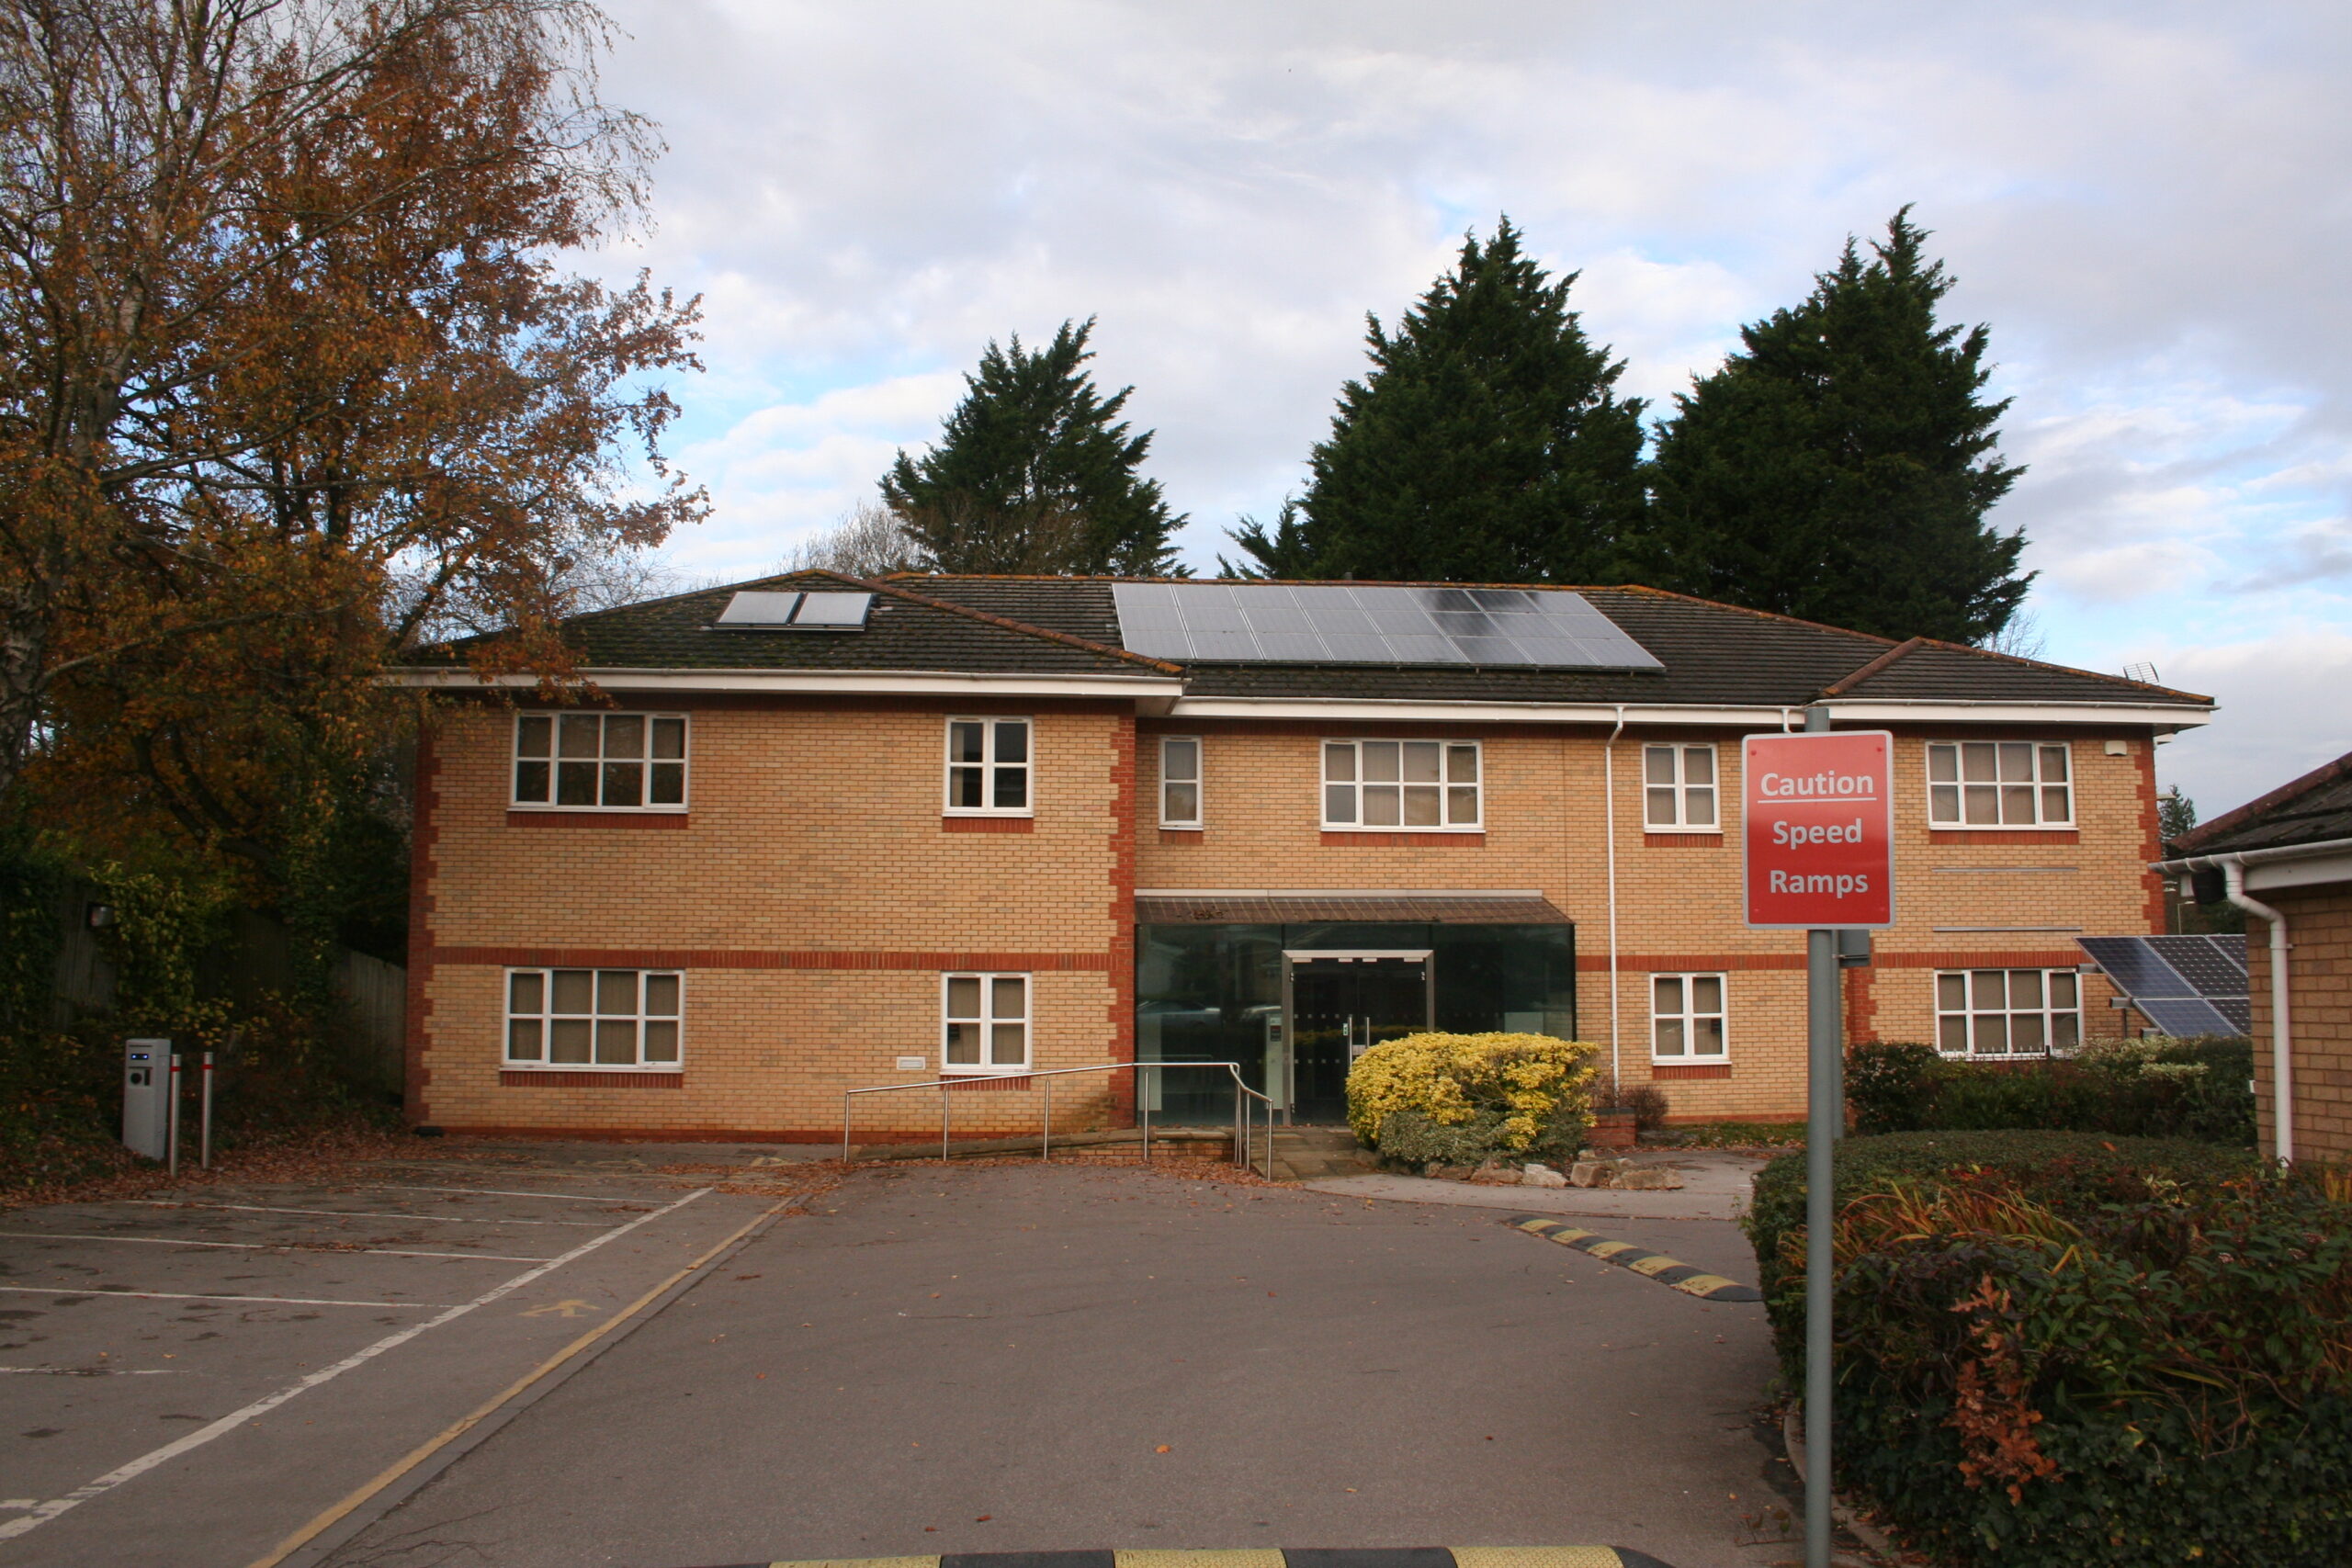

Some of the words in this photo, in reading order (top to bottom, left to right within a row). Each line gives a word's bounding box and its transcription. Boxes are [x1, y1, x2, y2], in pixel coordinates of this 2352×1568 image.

[1760, 770, 1874, 795] Caution
[1772, 818, 1862, 851] Speed
[1770, 869, 1869, 899] Ramps
